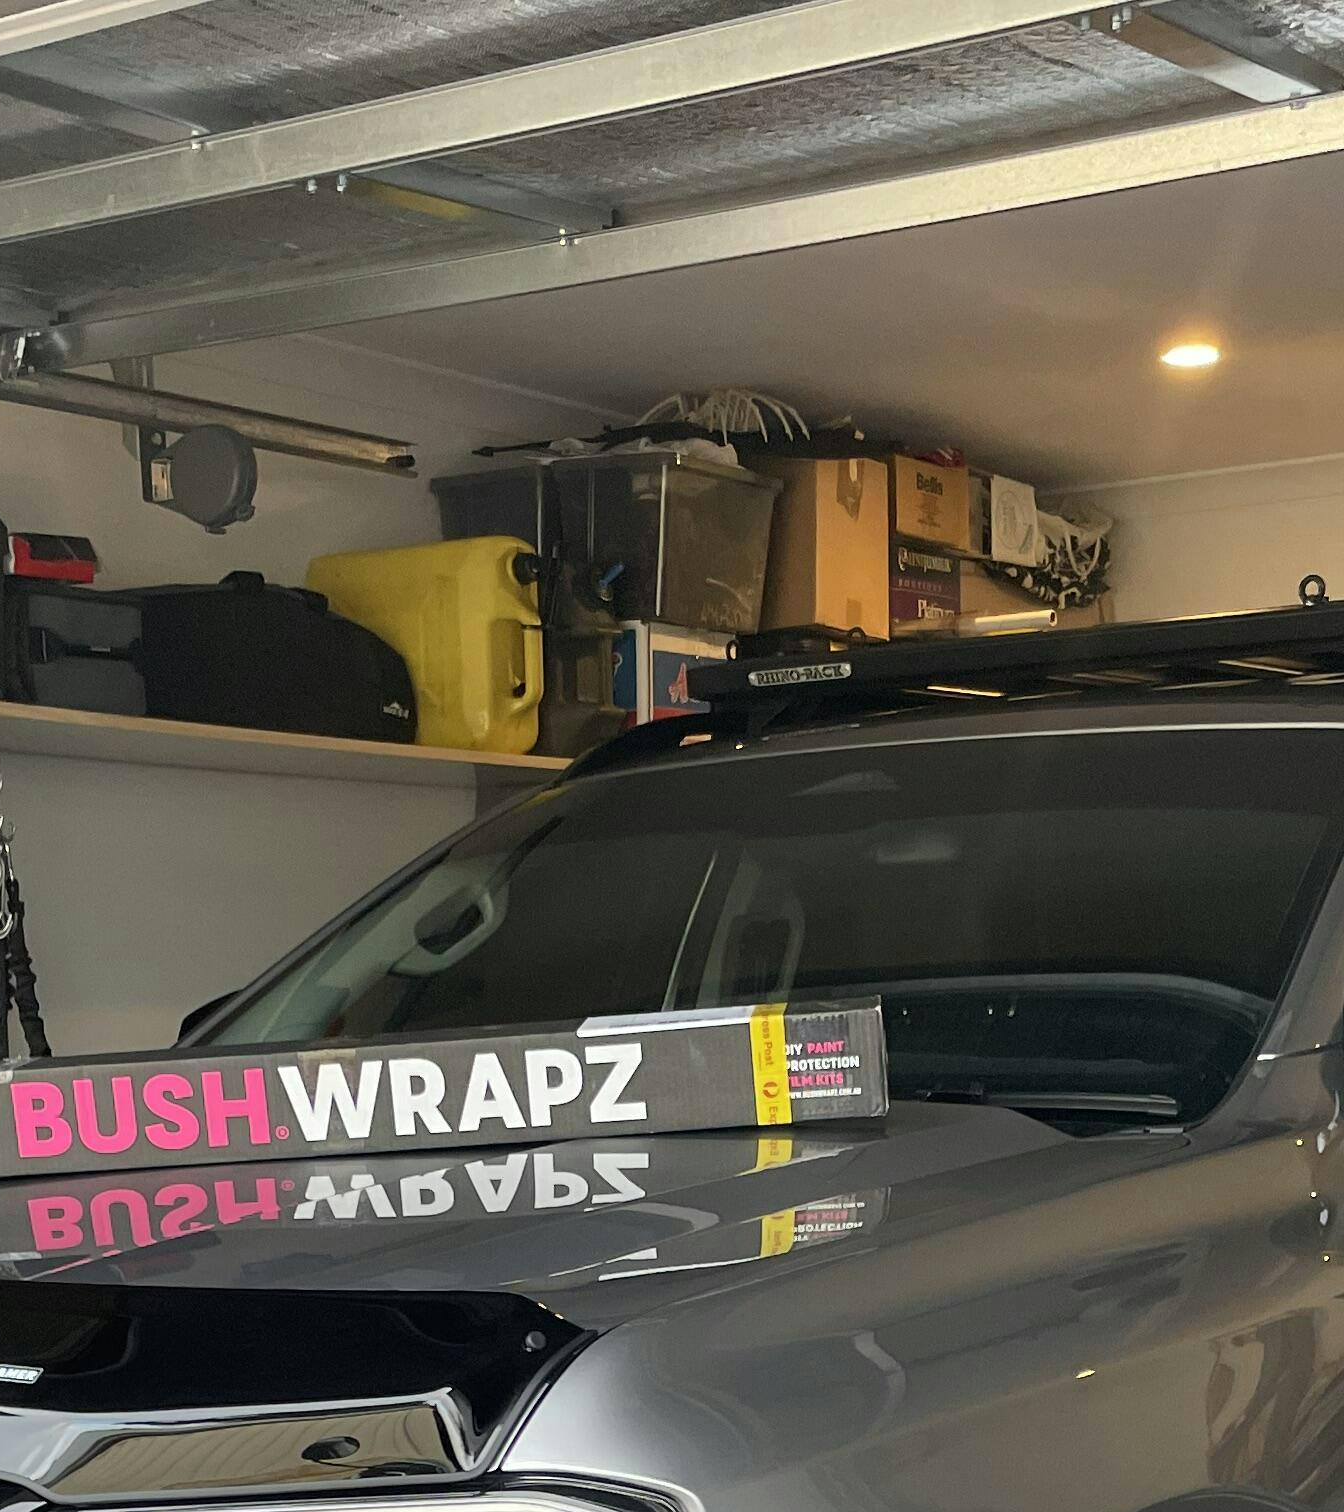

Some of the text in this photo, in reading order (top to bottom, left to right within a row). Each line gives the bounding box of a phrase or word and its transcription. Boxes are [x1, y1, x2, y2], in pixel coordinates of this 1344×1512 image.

[756, 664, 844, 685] RHINO-RACK
[807, 1040, 845, 1053] PAINT
[788, 1073, 844, 1087] ILM KITS
